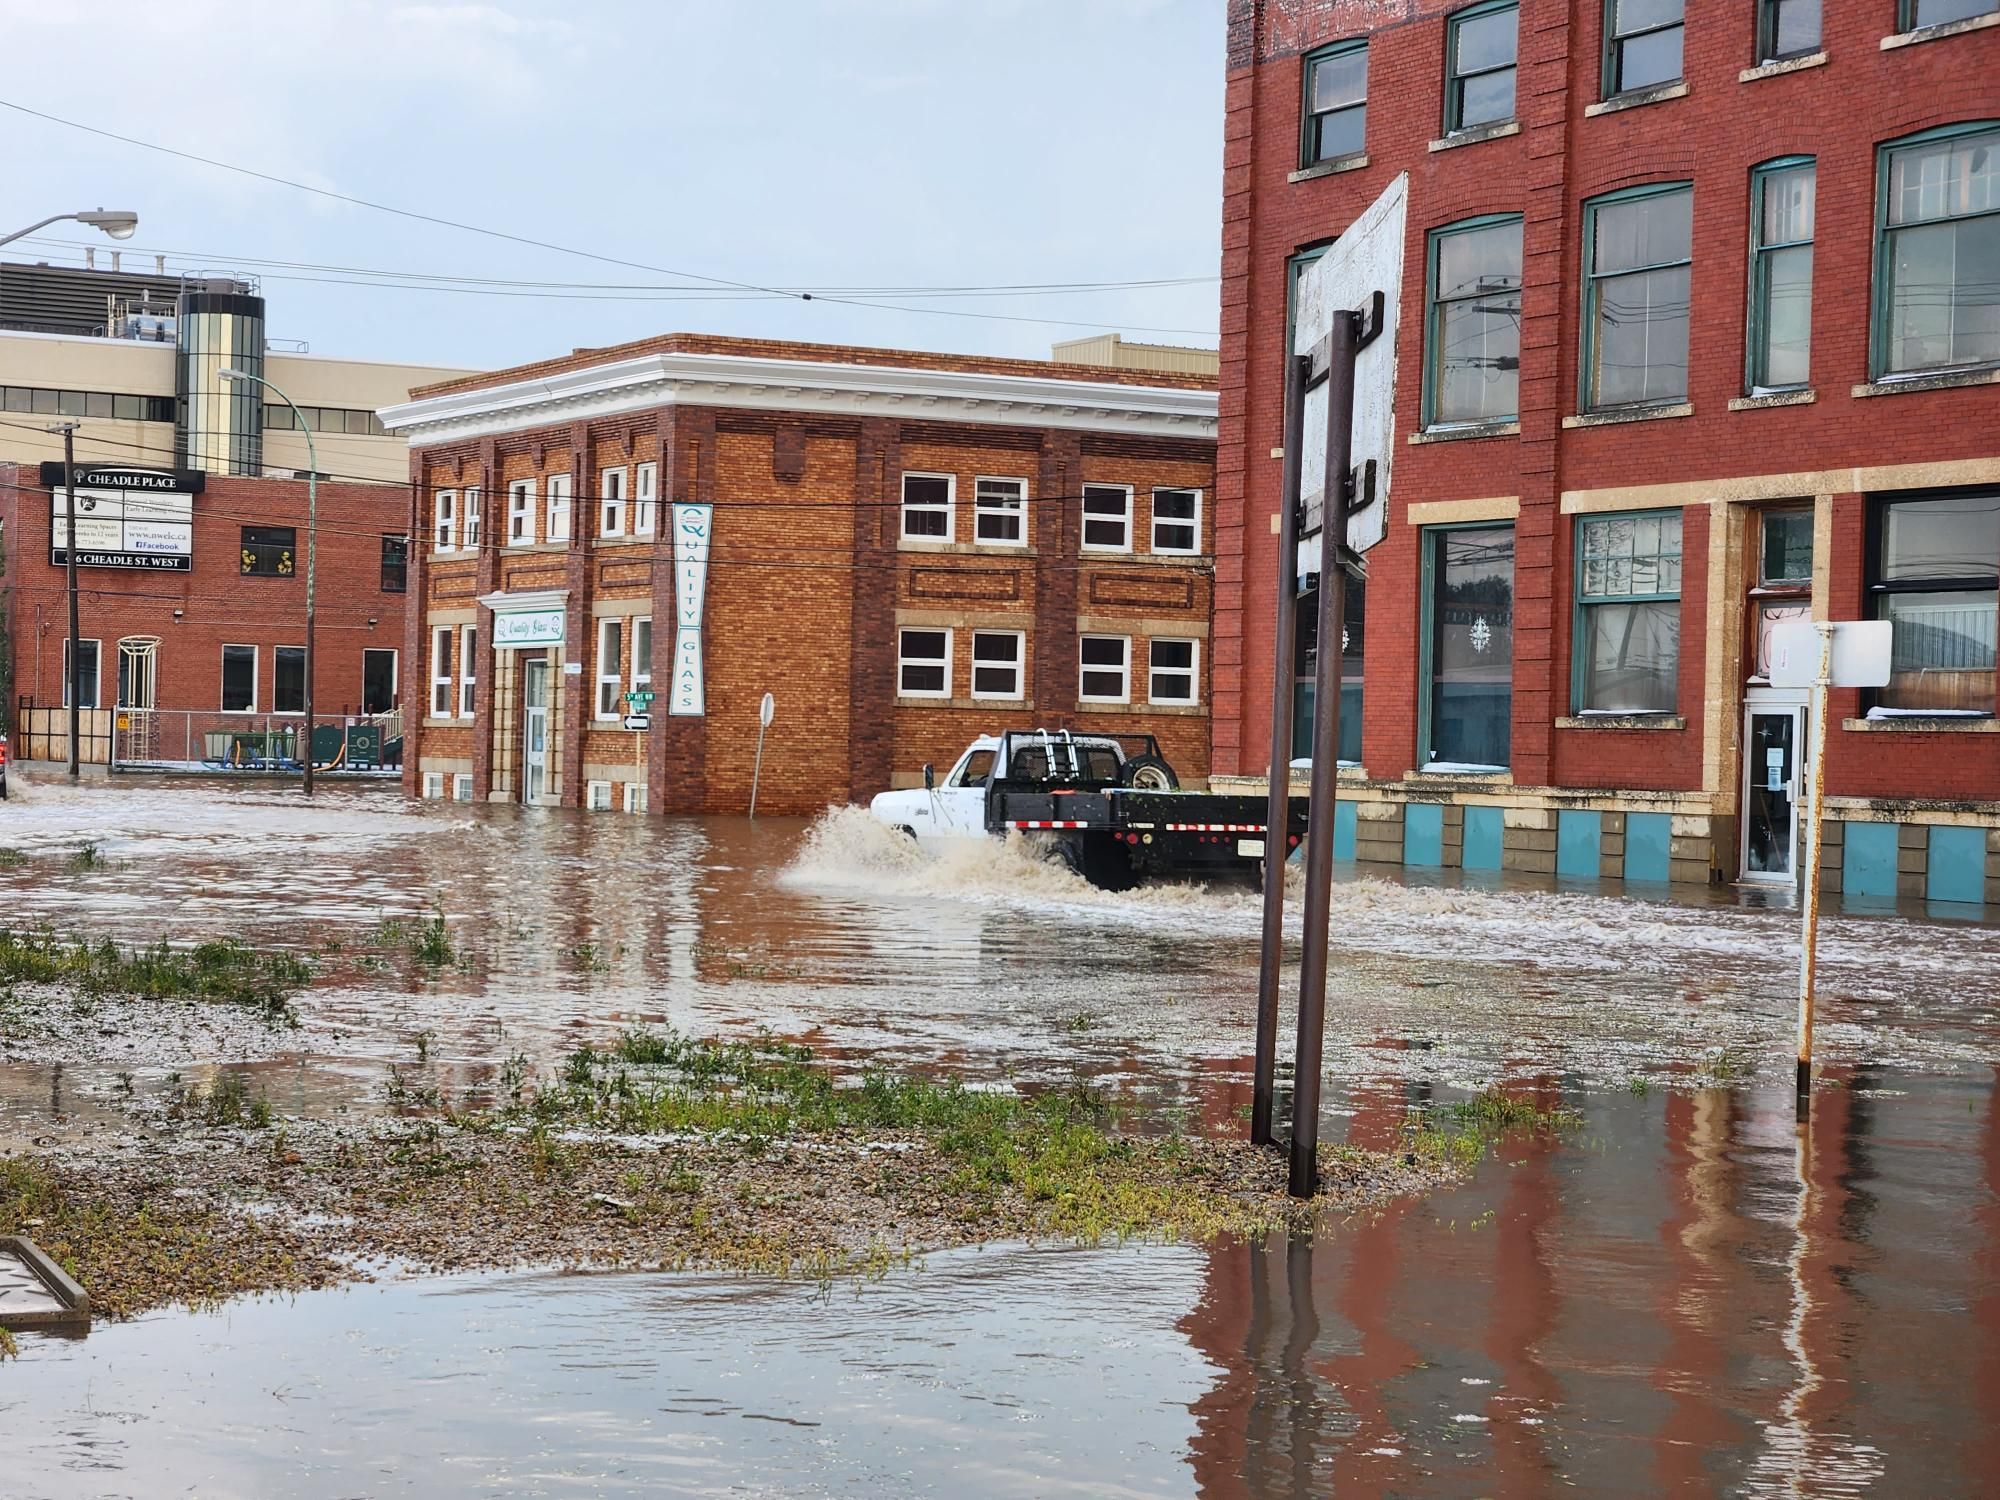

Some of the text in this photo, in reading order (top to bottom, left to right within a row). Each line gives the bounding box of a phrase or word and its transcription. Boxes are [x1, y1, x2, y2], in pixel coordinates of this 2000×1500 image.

[87, 474, 177, 488] CHEADLE PLACE
[143, 541, 179, 550] Facebook
[83, 554, 133, 565] CHEADLE
[134, 557, 149, 566] ST.
[150, 557, 180, 567] WEST
[681, 507, 705, 620] QUALITY
[682, 642, 696, 706] GLASS
